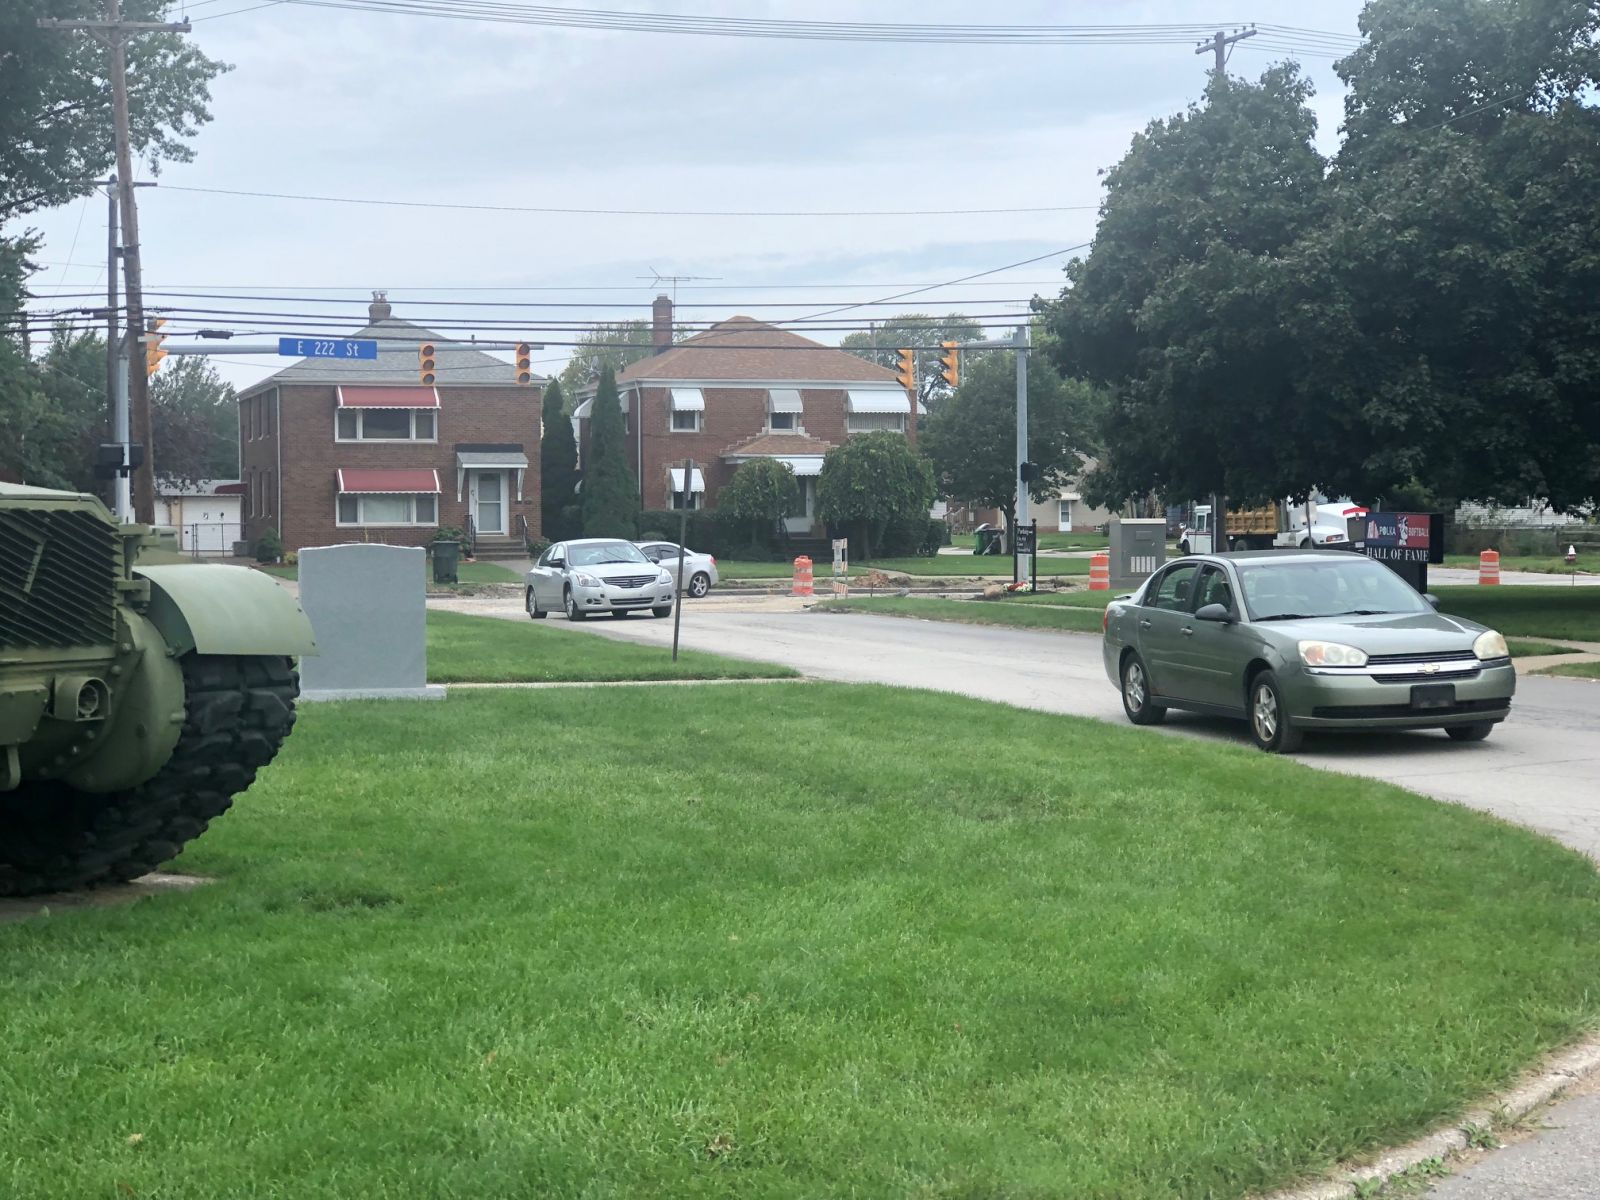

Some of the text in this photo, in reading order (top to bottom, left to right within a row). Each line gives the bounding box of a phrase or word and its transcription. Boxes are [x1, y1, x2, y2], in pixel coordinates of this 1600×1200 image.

[297, 341, 359, 356] E 222 St
[1379, 526, 1429, 537] POLKA SOFTBALL
[1367, 547, 1429, 561] HALL OF FAME
